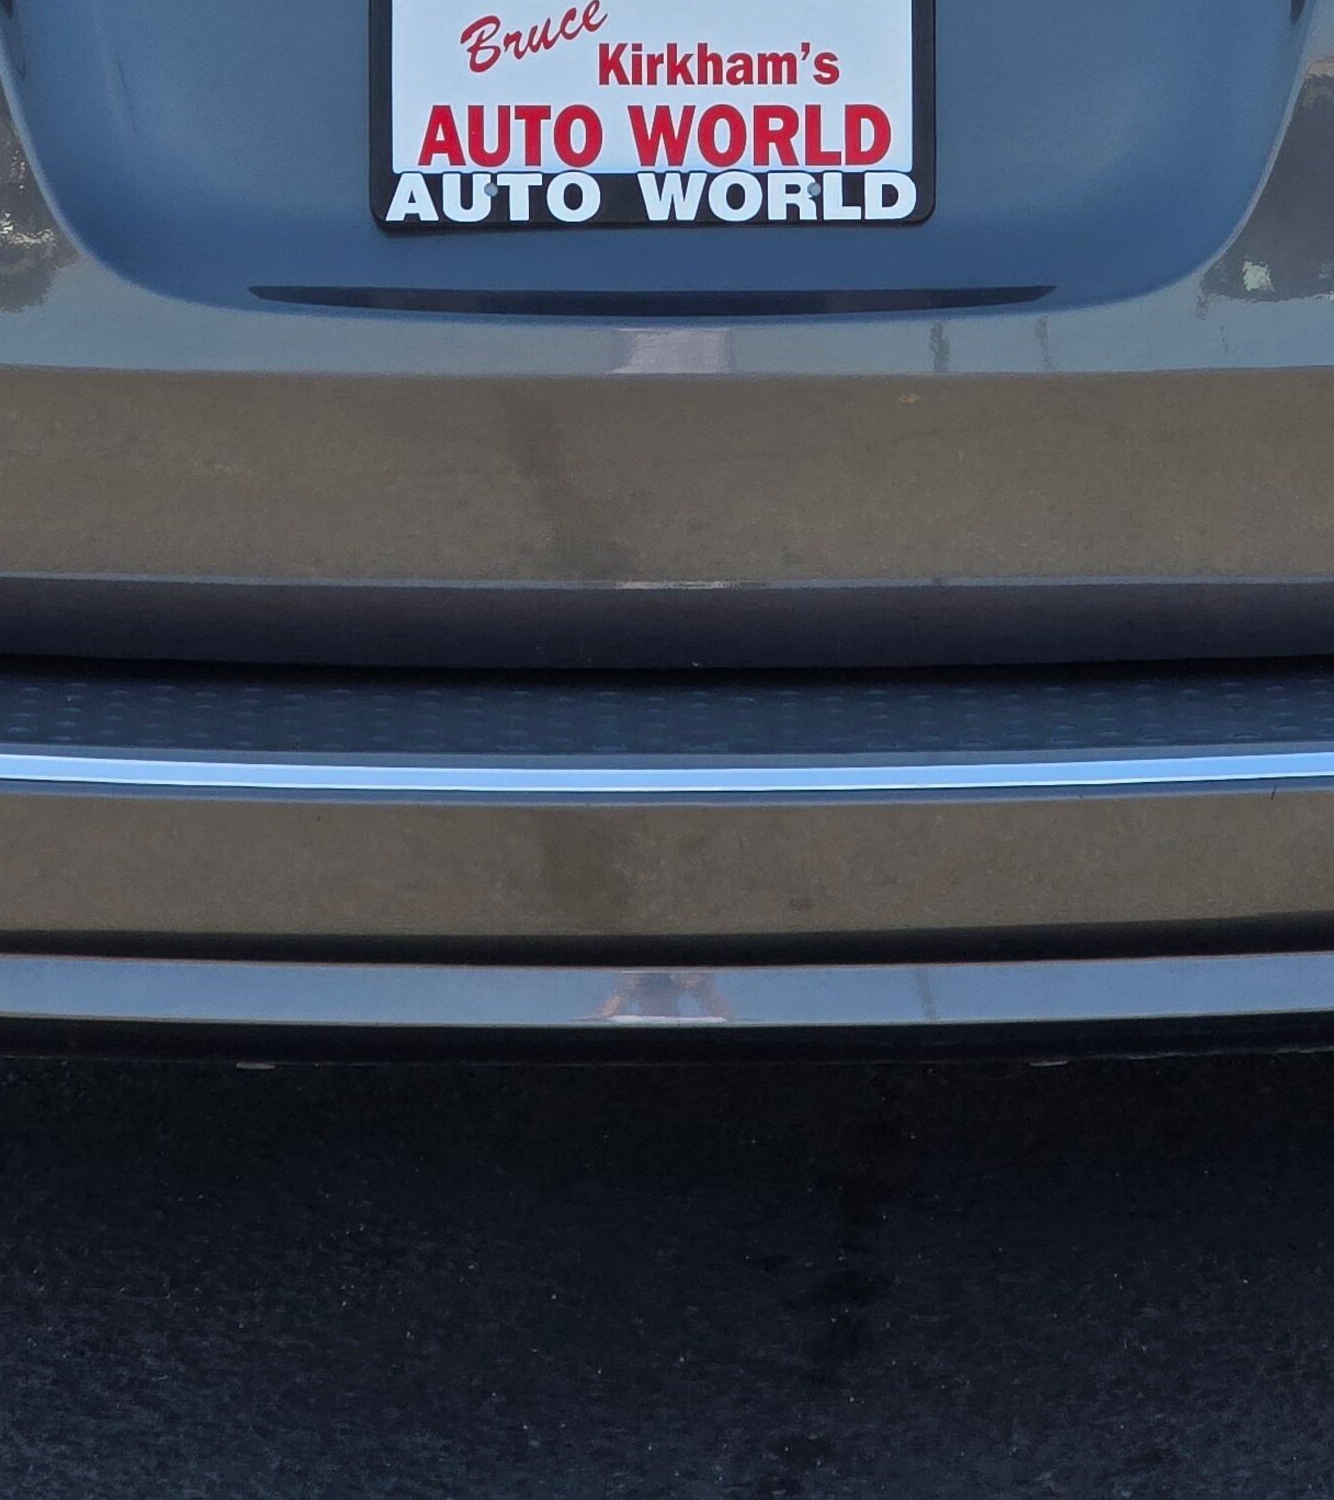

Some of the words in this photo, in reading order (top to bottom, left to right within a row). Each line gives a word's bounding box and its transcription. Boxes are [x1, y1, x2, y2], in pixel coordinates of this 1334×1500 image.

[598, 41, 840, 86] Kirkham's
[418, 103, 603, 167] AUTO
[628, 103, 892, 167] WORLD
[385, 171, 601, 222] AUTO
[636, 171, 917, 222] WORLD
